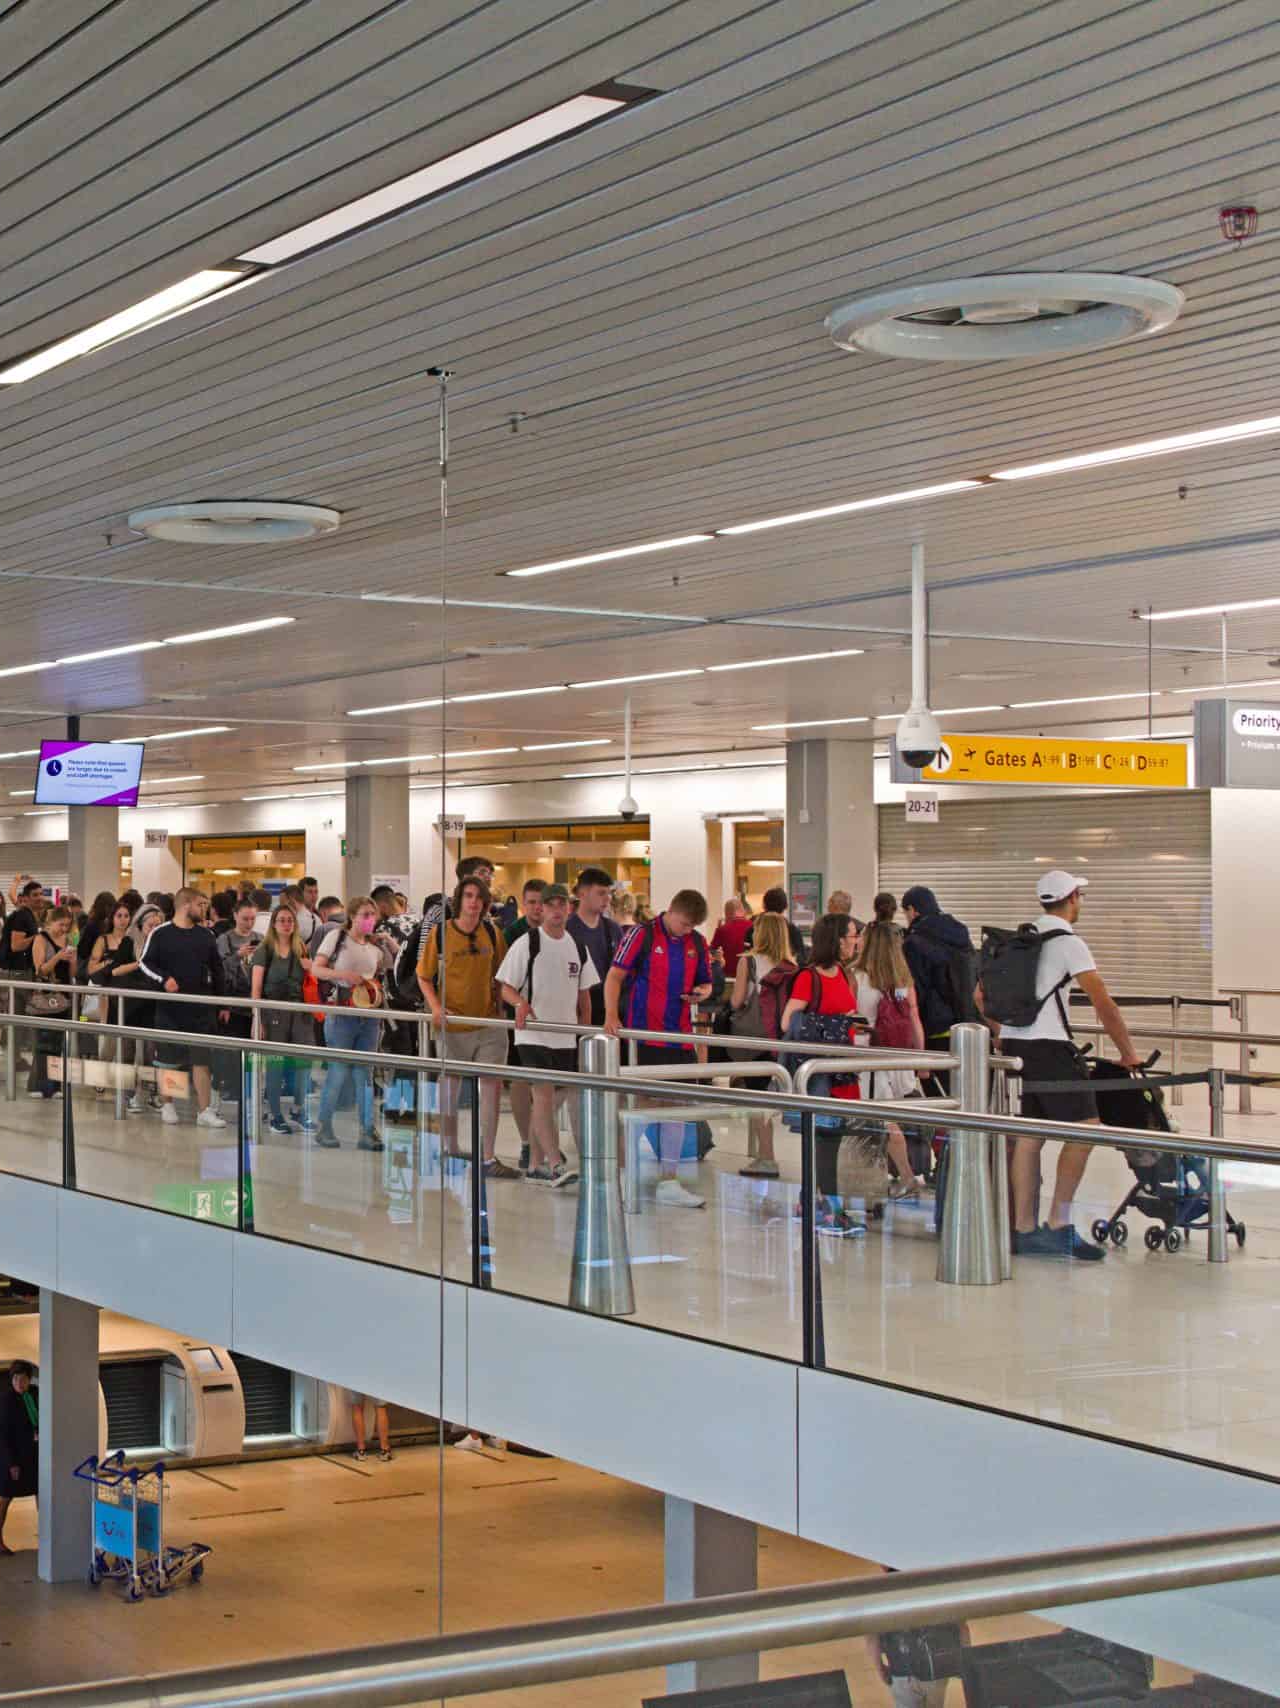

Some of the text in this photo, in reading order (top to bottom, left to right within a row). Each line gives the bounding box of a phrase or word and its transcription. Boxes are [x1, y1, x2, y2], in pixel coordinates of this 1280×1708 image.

[1240, 713, 1280, 732] Priority
[984, 750, 1026, 767] Gates
[908, 800, 936, 813] 20-21
